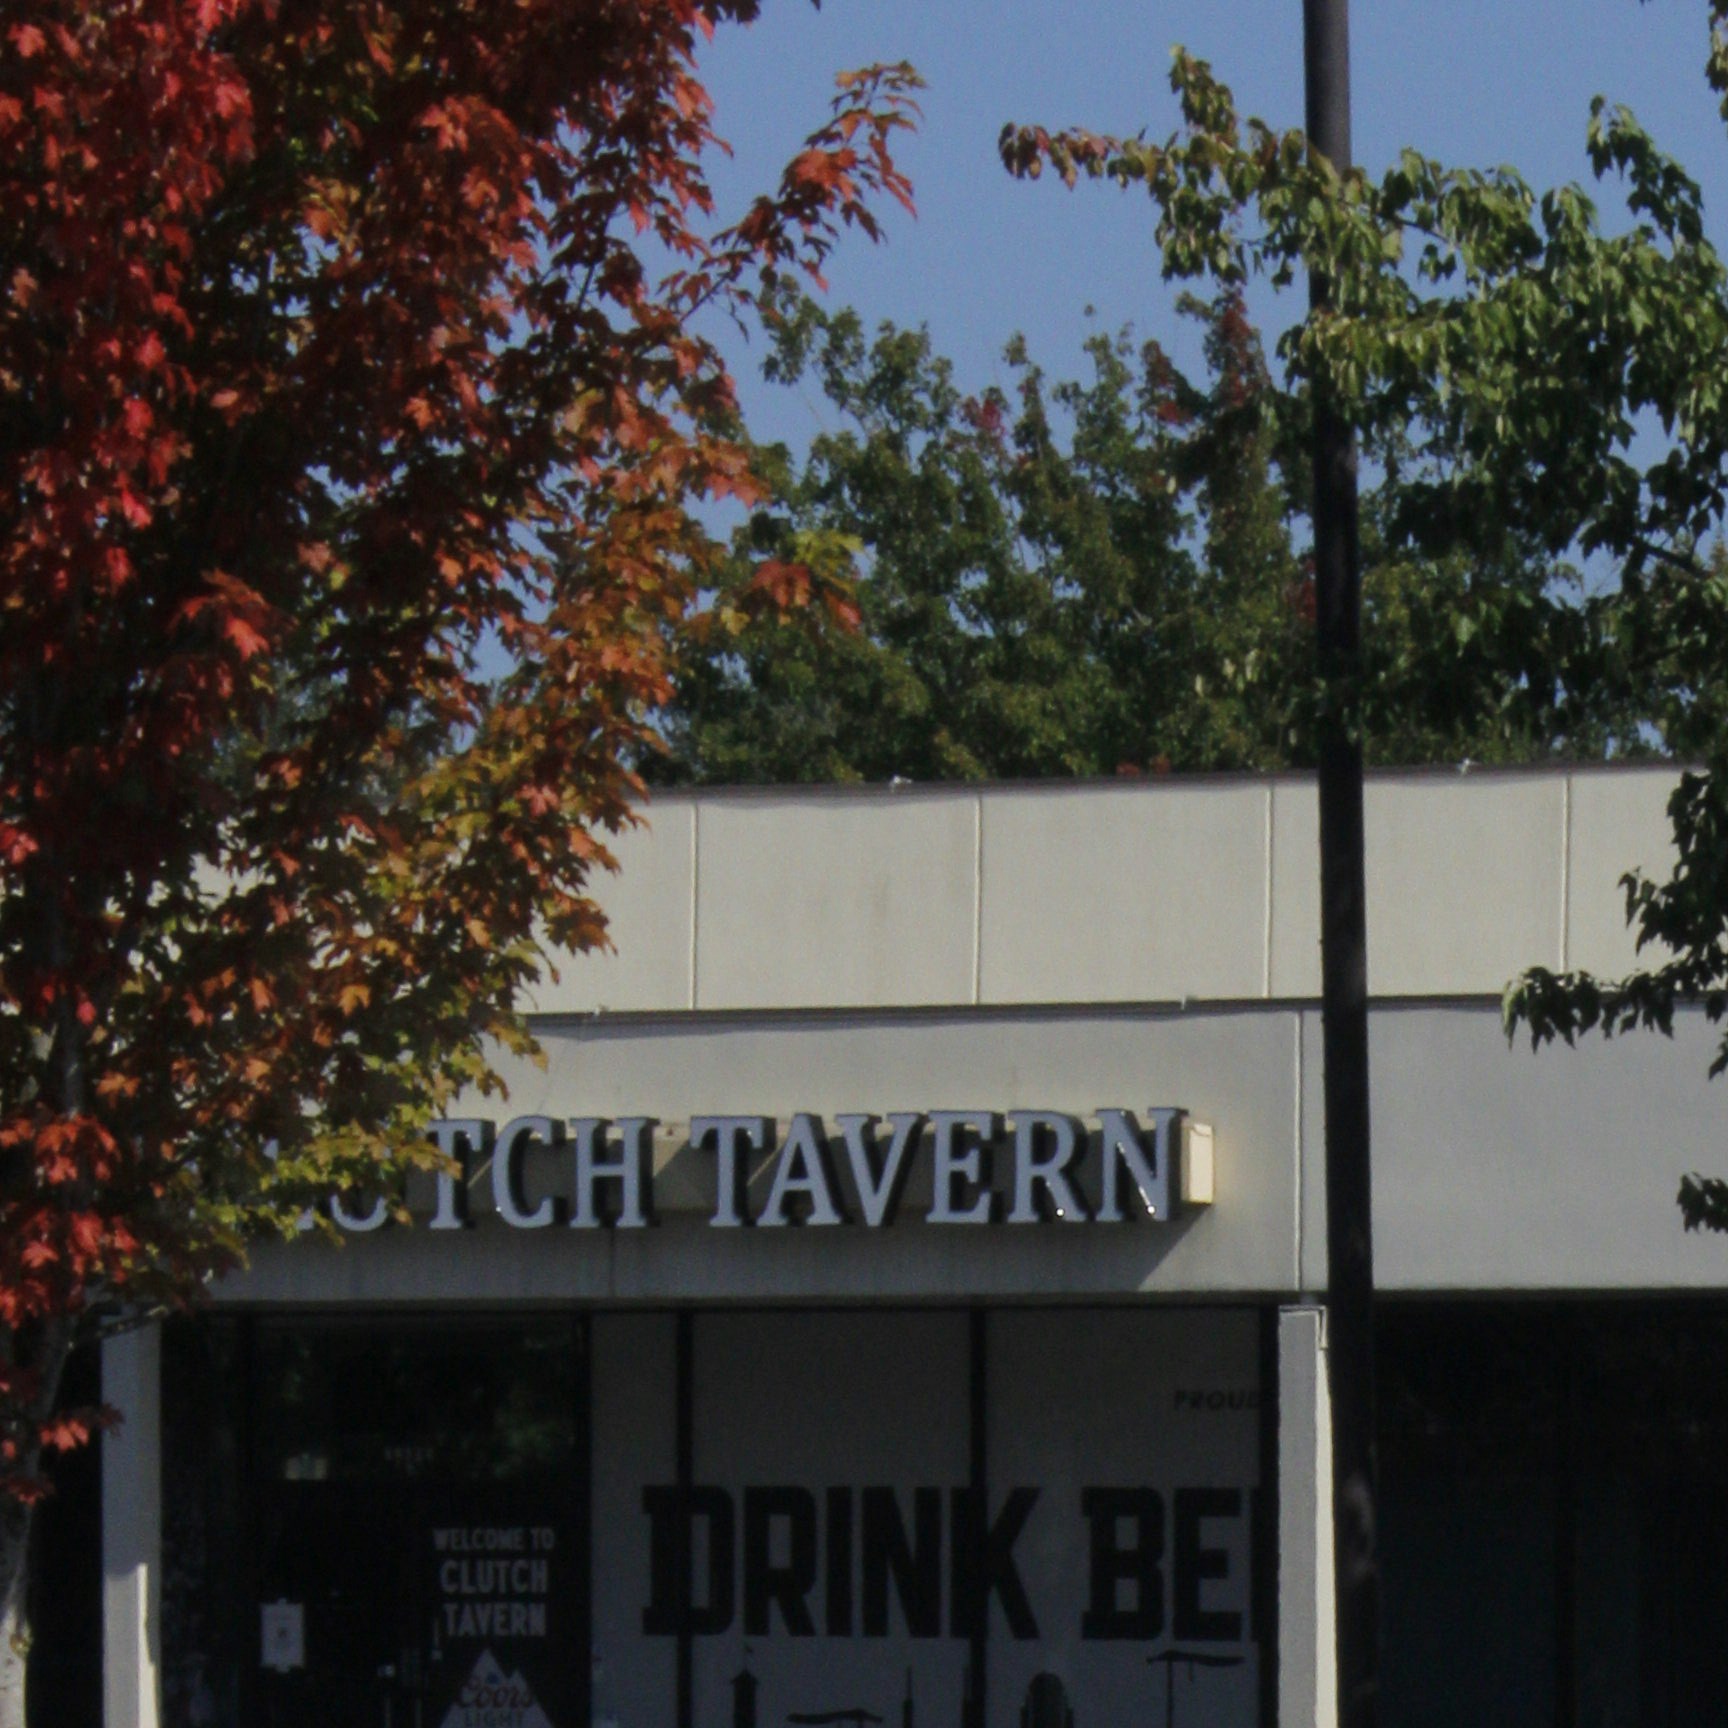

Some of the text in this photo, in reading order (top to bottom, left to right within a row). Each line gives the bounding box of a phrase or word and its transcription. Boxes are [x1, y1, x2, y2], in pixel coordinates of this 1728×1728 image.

[689, 1106, 1188, 1228] TAVERN
[433, 1527, 555, 1551] WELCOME TO
[440, 1560, 548, 1594] CLUTCH
[642, 1485, 1042, 1640] DRINK
[443, 1603, 546, 1637] TAVERN
